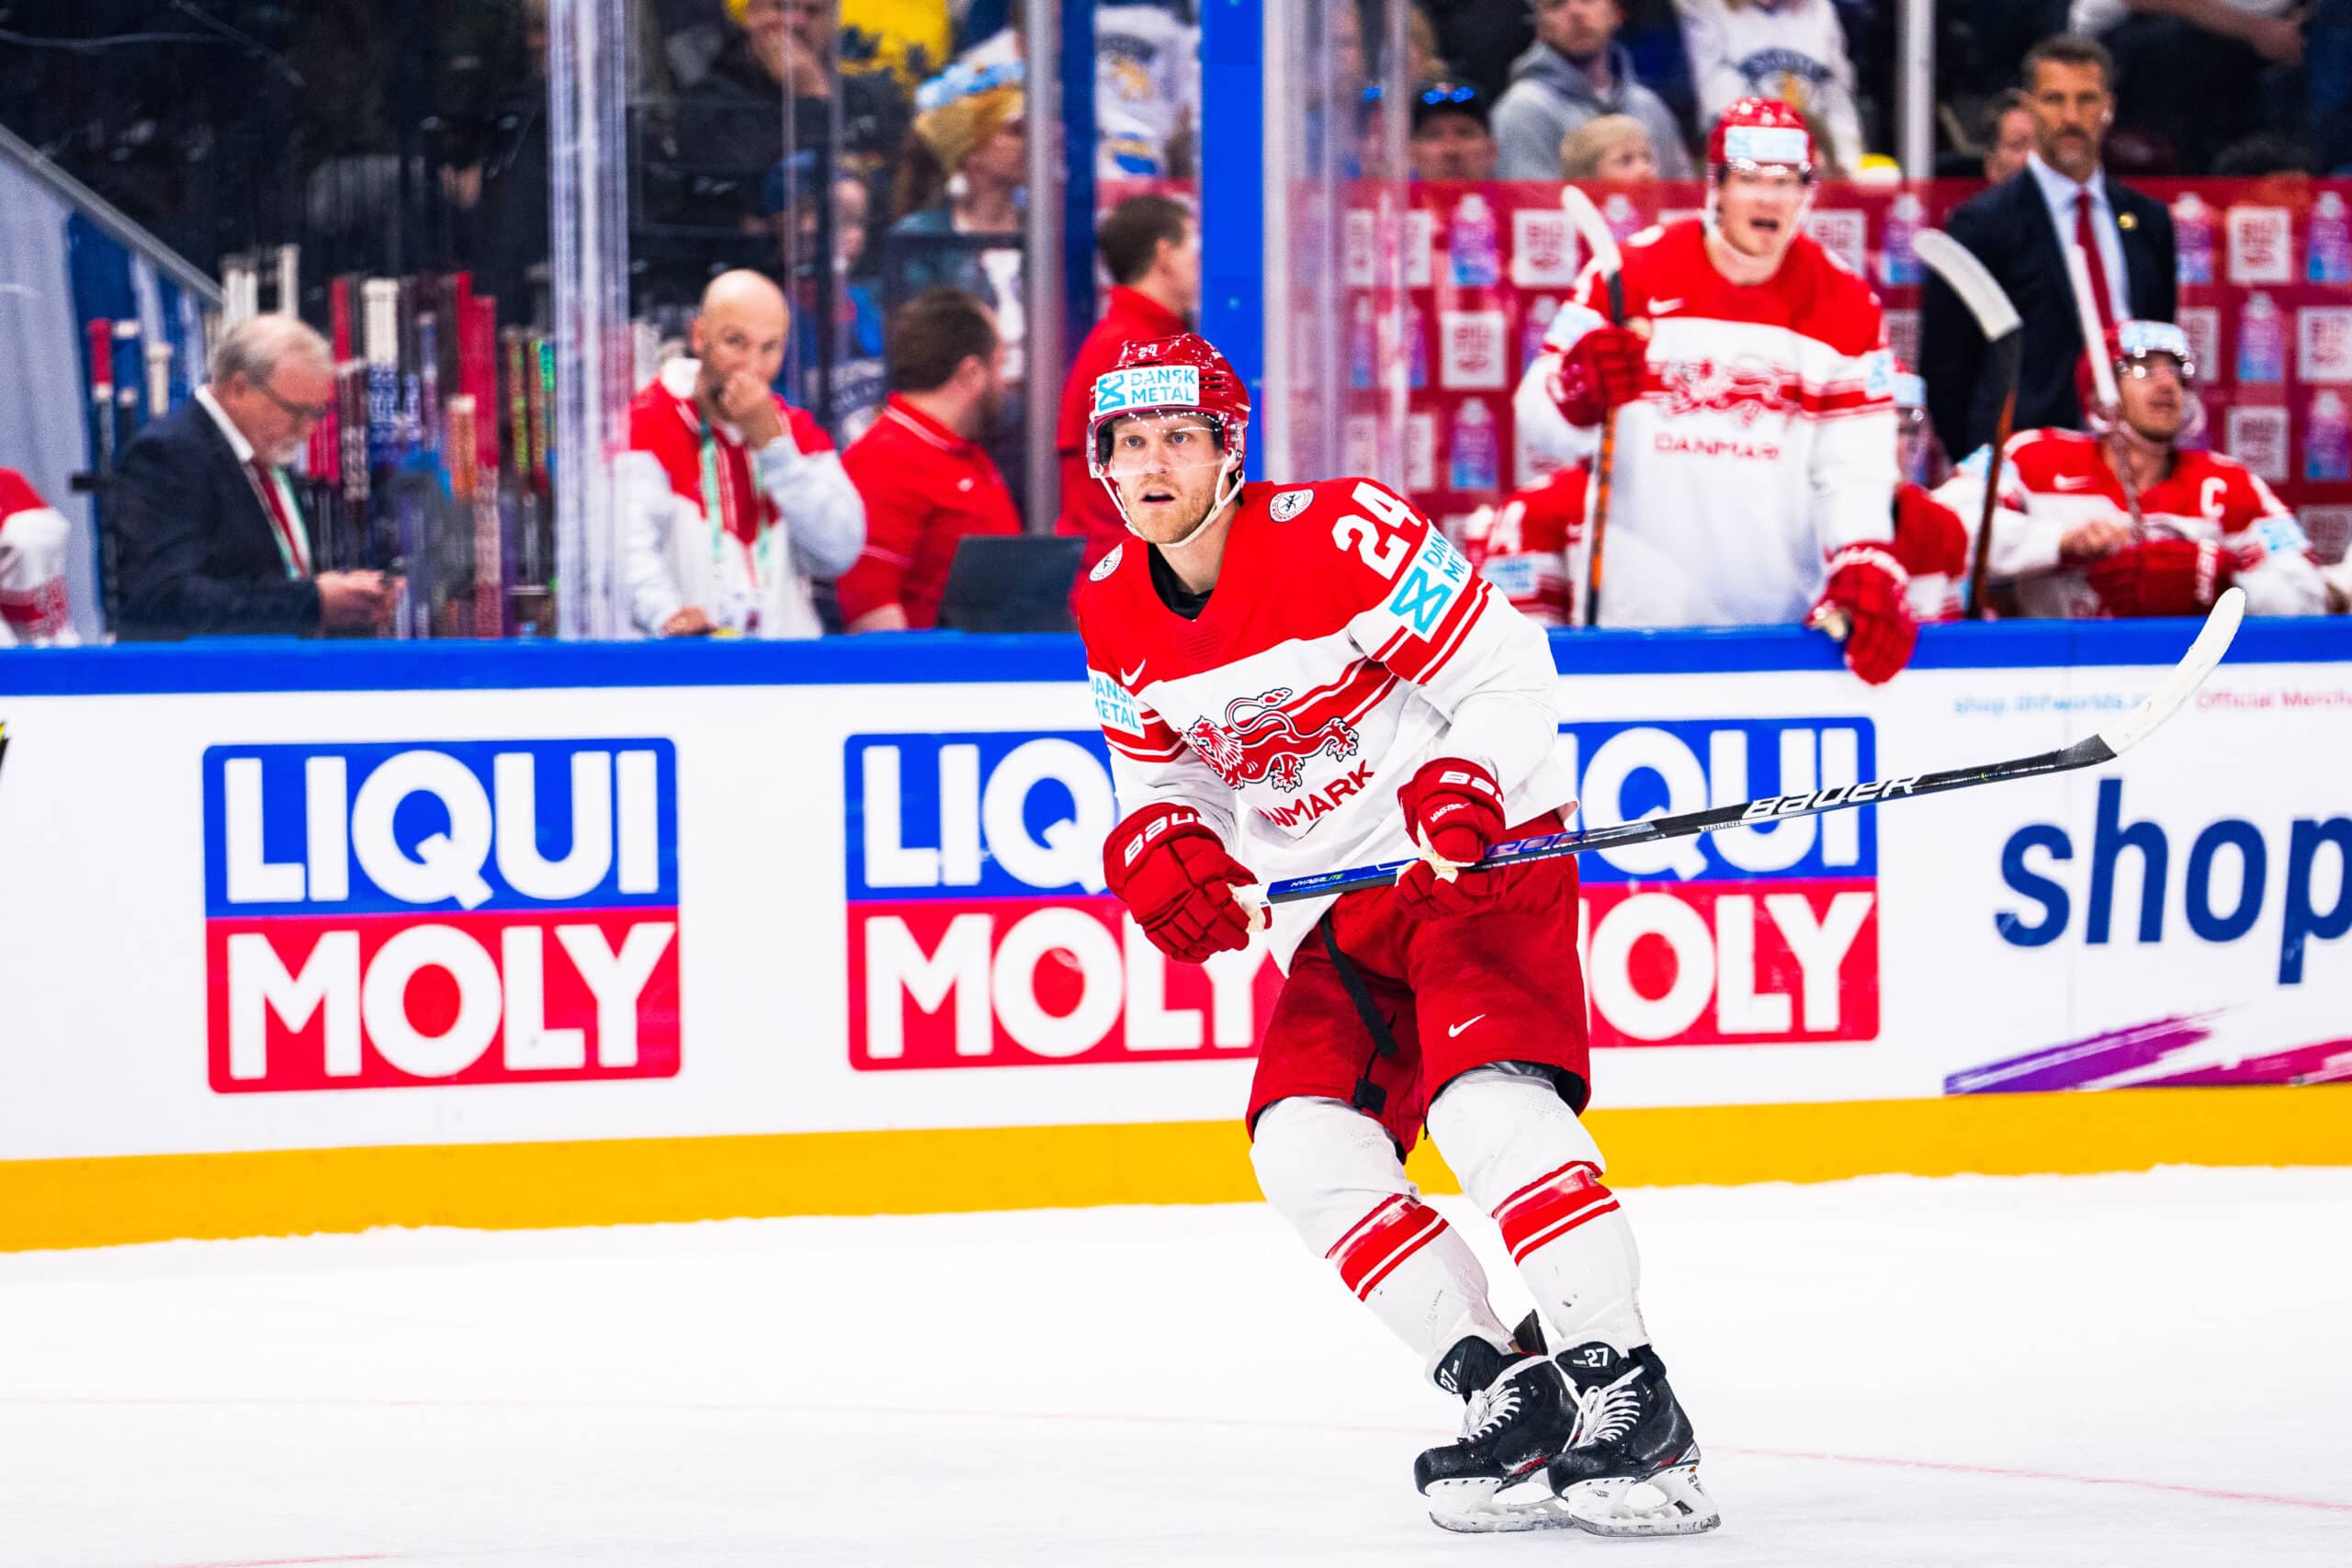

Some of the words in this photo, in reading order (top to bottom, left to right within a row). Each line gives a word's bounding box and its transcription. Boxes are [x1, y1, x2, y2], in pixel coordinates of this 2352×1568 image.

[1130, 368, 1196, 387] DANSK
[1130, 386, 1194, 404] METAL
[1137, 344, 1159, 358] 24
[1331, 481, 1422, 581] 24
[2200, 476, 2228, 517] C
[224, 749, 659, 910] LIQUI
[863, 738, 1117, 896] LIQ
[1994, 777, 2352, 987] shop
[226, 922, 676, 1080] MOLY
[865, 906, 1269, 1058] MOLY
[1577, 892, 1875, 1041] OLY
[1584, 1347, 1609, 1368] 27
